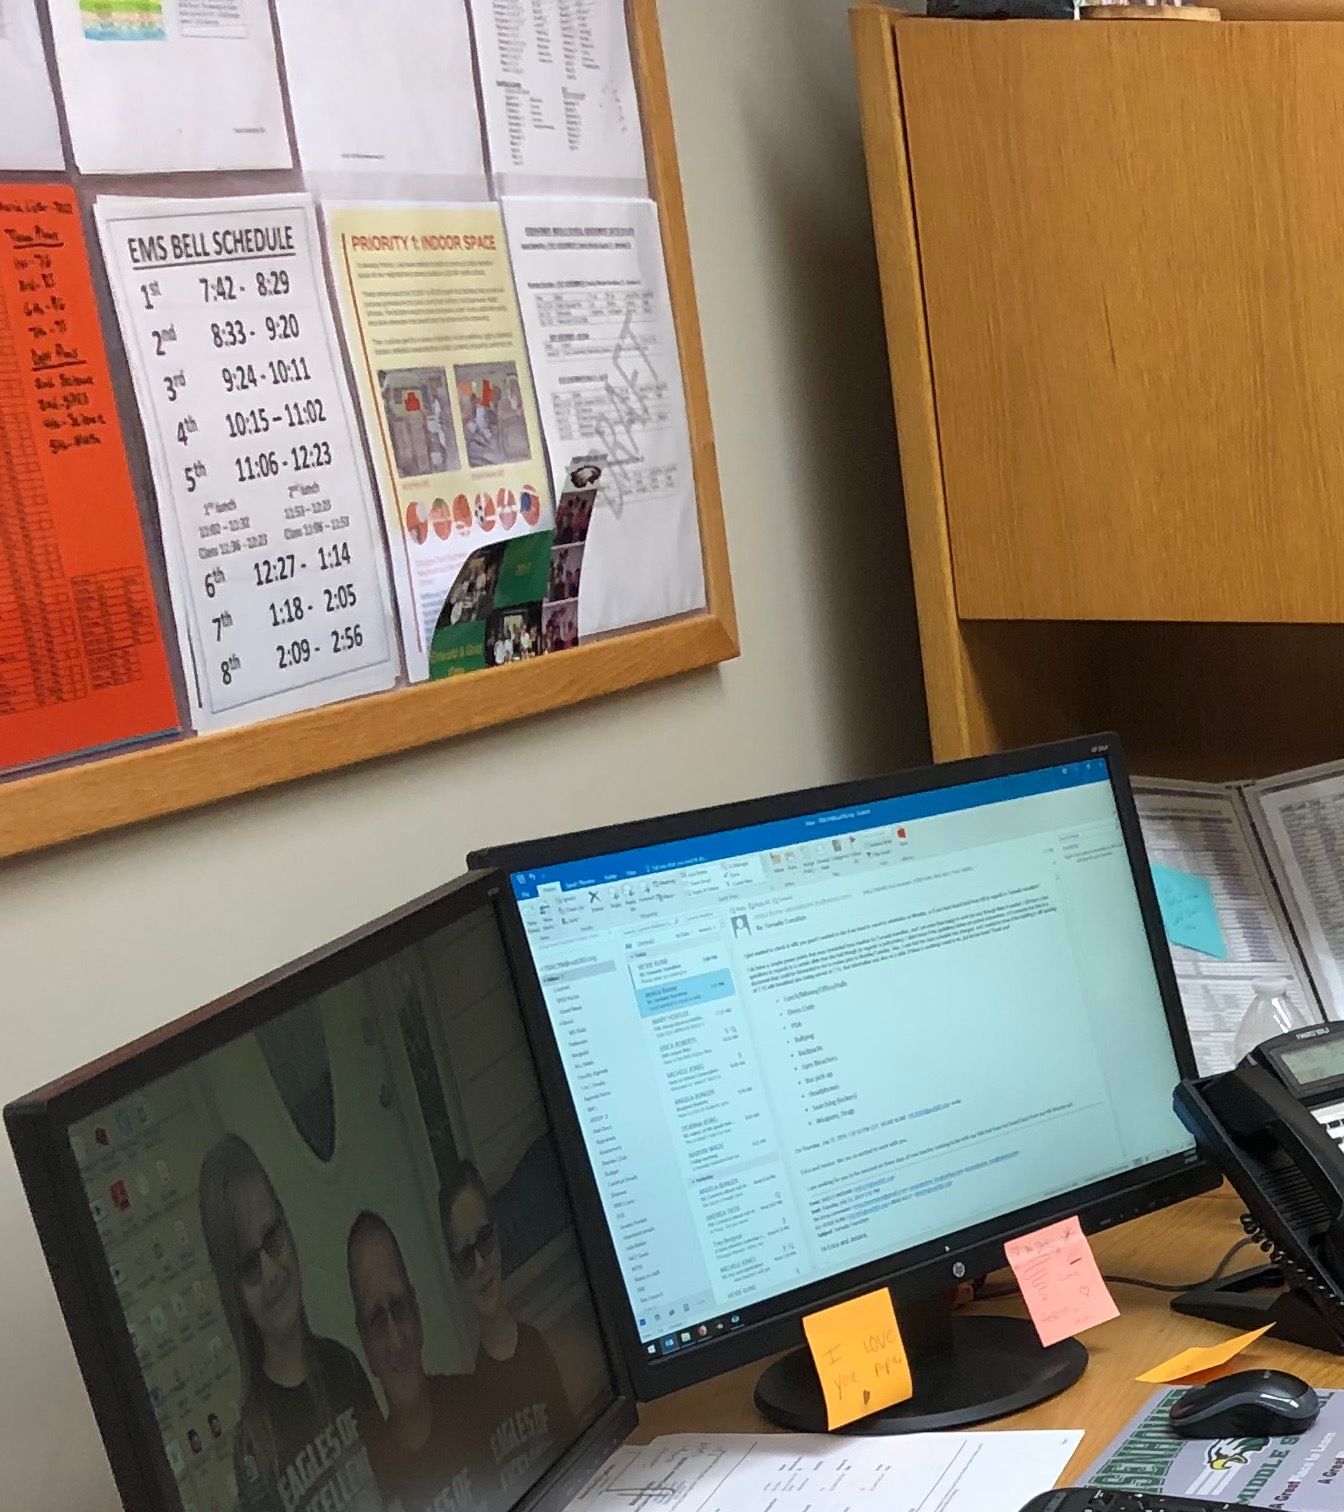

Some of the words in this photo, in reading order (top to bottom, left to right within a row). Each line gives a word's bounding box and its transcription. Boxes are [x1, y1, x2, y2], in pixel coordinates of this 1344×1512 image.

[128, 235, 168, 263] EMS
[171, 232, 210, 259] BELL
[213, 226, 295, 255] SCHEDULE
[352, 235, 408, 251] PRIORITY
[421, 235, 463, 250] INDOOR
[463, 234, 496, 250] SPACE
[140, 280, 162, 310] 1st
[199, 275, 236, 302] 7:42
[256, 270, 290, 297] 8:29
[211, 320, 247, 348] 8:33
[266, 314, 300, 340] 9:20
[222, 365, 257, 392] 9:24
[269, 357, 311, 385] 10:11
[177, 415, 198, 446] 4th
[226, 408, 269, 437] 10:15
[285, 399, 326, 427] 11:02
[184, 460, 207, 492] 5th
[236, 451, 279, 482] 11:06
[291, 442, 332, 471] 12:23
[205, 566, 226, 598] 6th
[254, 554, 295, 586] 12:27
[318, 542, 351, 570] 1:14
[212, 610, 233, 641] 7th
[269, 597, 304, 626] 1:18
[324, 583, 356, 612] 2:05
[221, 652, 241, 685] 8th
[276, 638, 310, 668] 2:09
[331, 623, 363, 653] 2:56
[1237, 1449, 1291, 1505] MIDDLE
[1274, 1481, 1301, 1502] Great
[1288, 1464, 1311, 1482] Place
